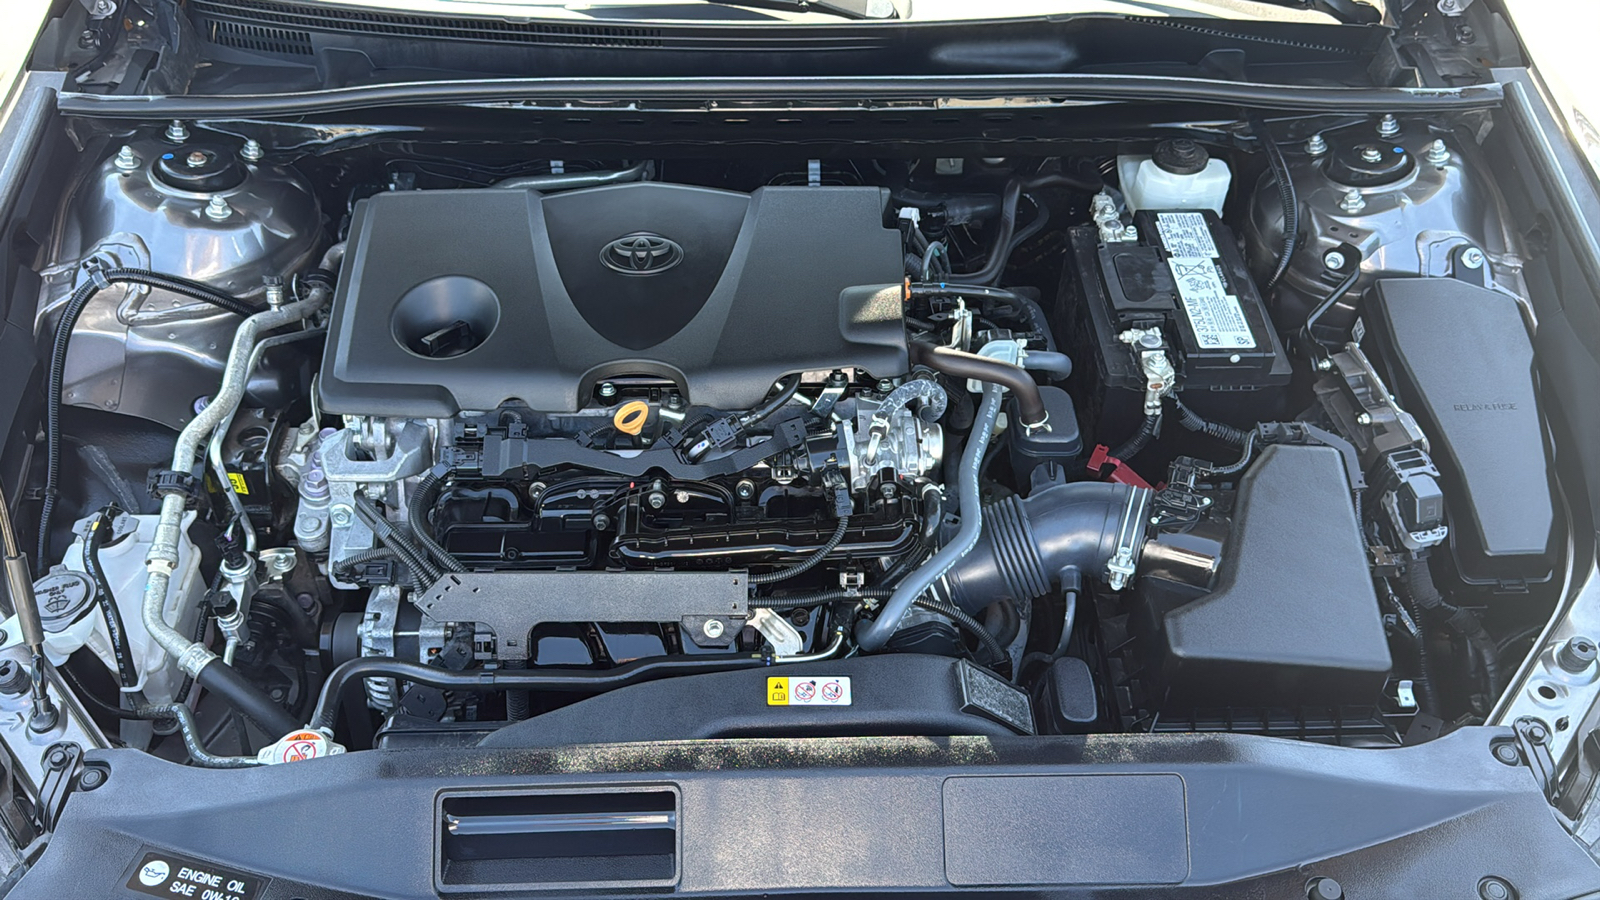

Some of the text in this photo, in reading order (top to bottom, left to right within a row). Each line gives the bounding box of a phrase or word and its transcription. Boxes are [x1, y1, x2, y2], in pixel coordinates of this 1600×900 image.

[170, 881, 196, 896] SAE
[177, 867, 245, 893] ENGINE OIL
